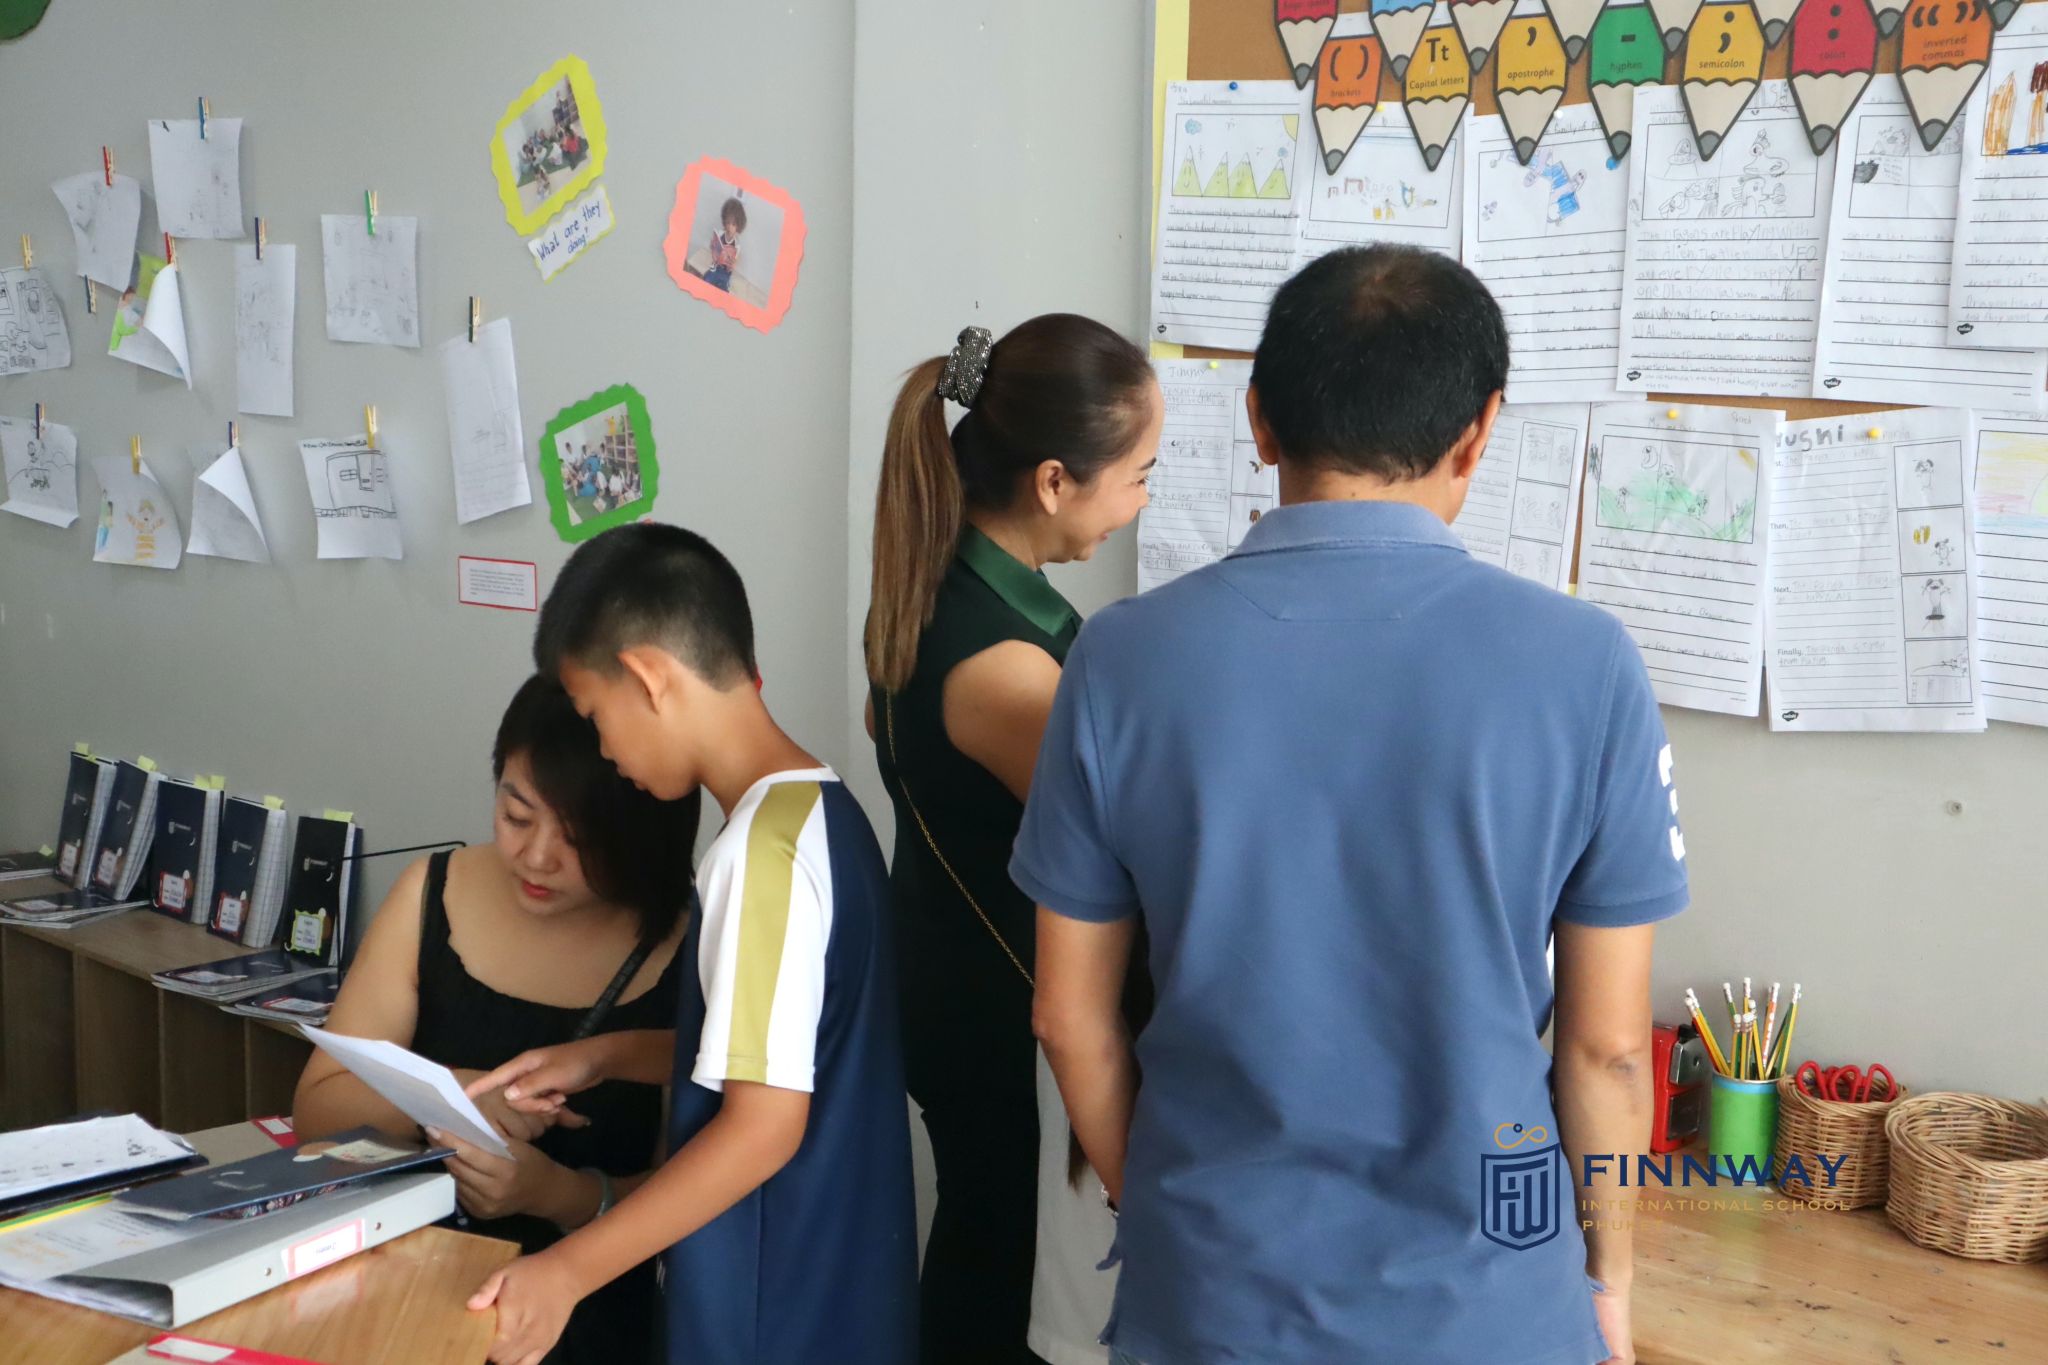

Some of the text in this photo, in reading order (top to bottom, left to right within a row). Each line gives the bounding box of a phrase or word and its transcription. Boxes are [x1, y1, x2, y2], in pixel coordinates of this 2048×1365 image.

[1922, 34, 1968, 50] inverted
[1818, 49, 1846, 60] colon
[1921, 49, 1965, 62] commas
[1609, 60, 1644, 73] hyphen
[1698, 58, 1746, 70] semicolon
[1507, 67, 1555, 81] apostrophe
[1409, 75, 1465, 91] Capital letters
[1330, 88, 1362, 98] brackets
[536, 200, 601, 261] What are they
